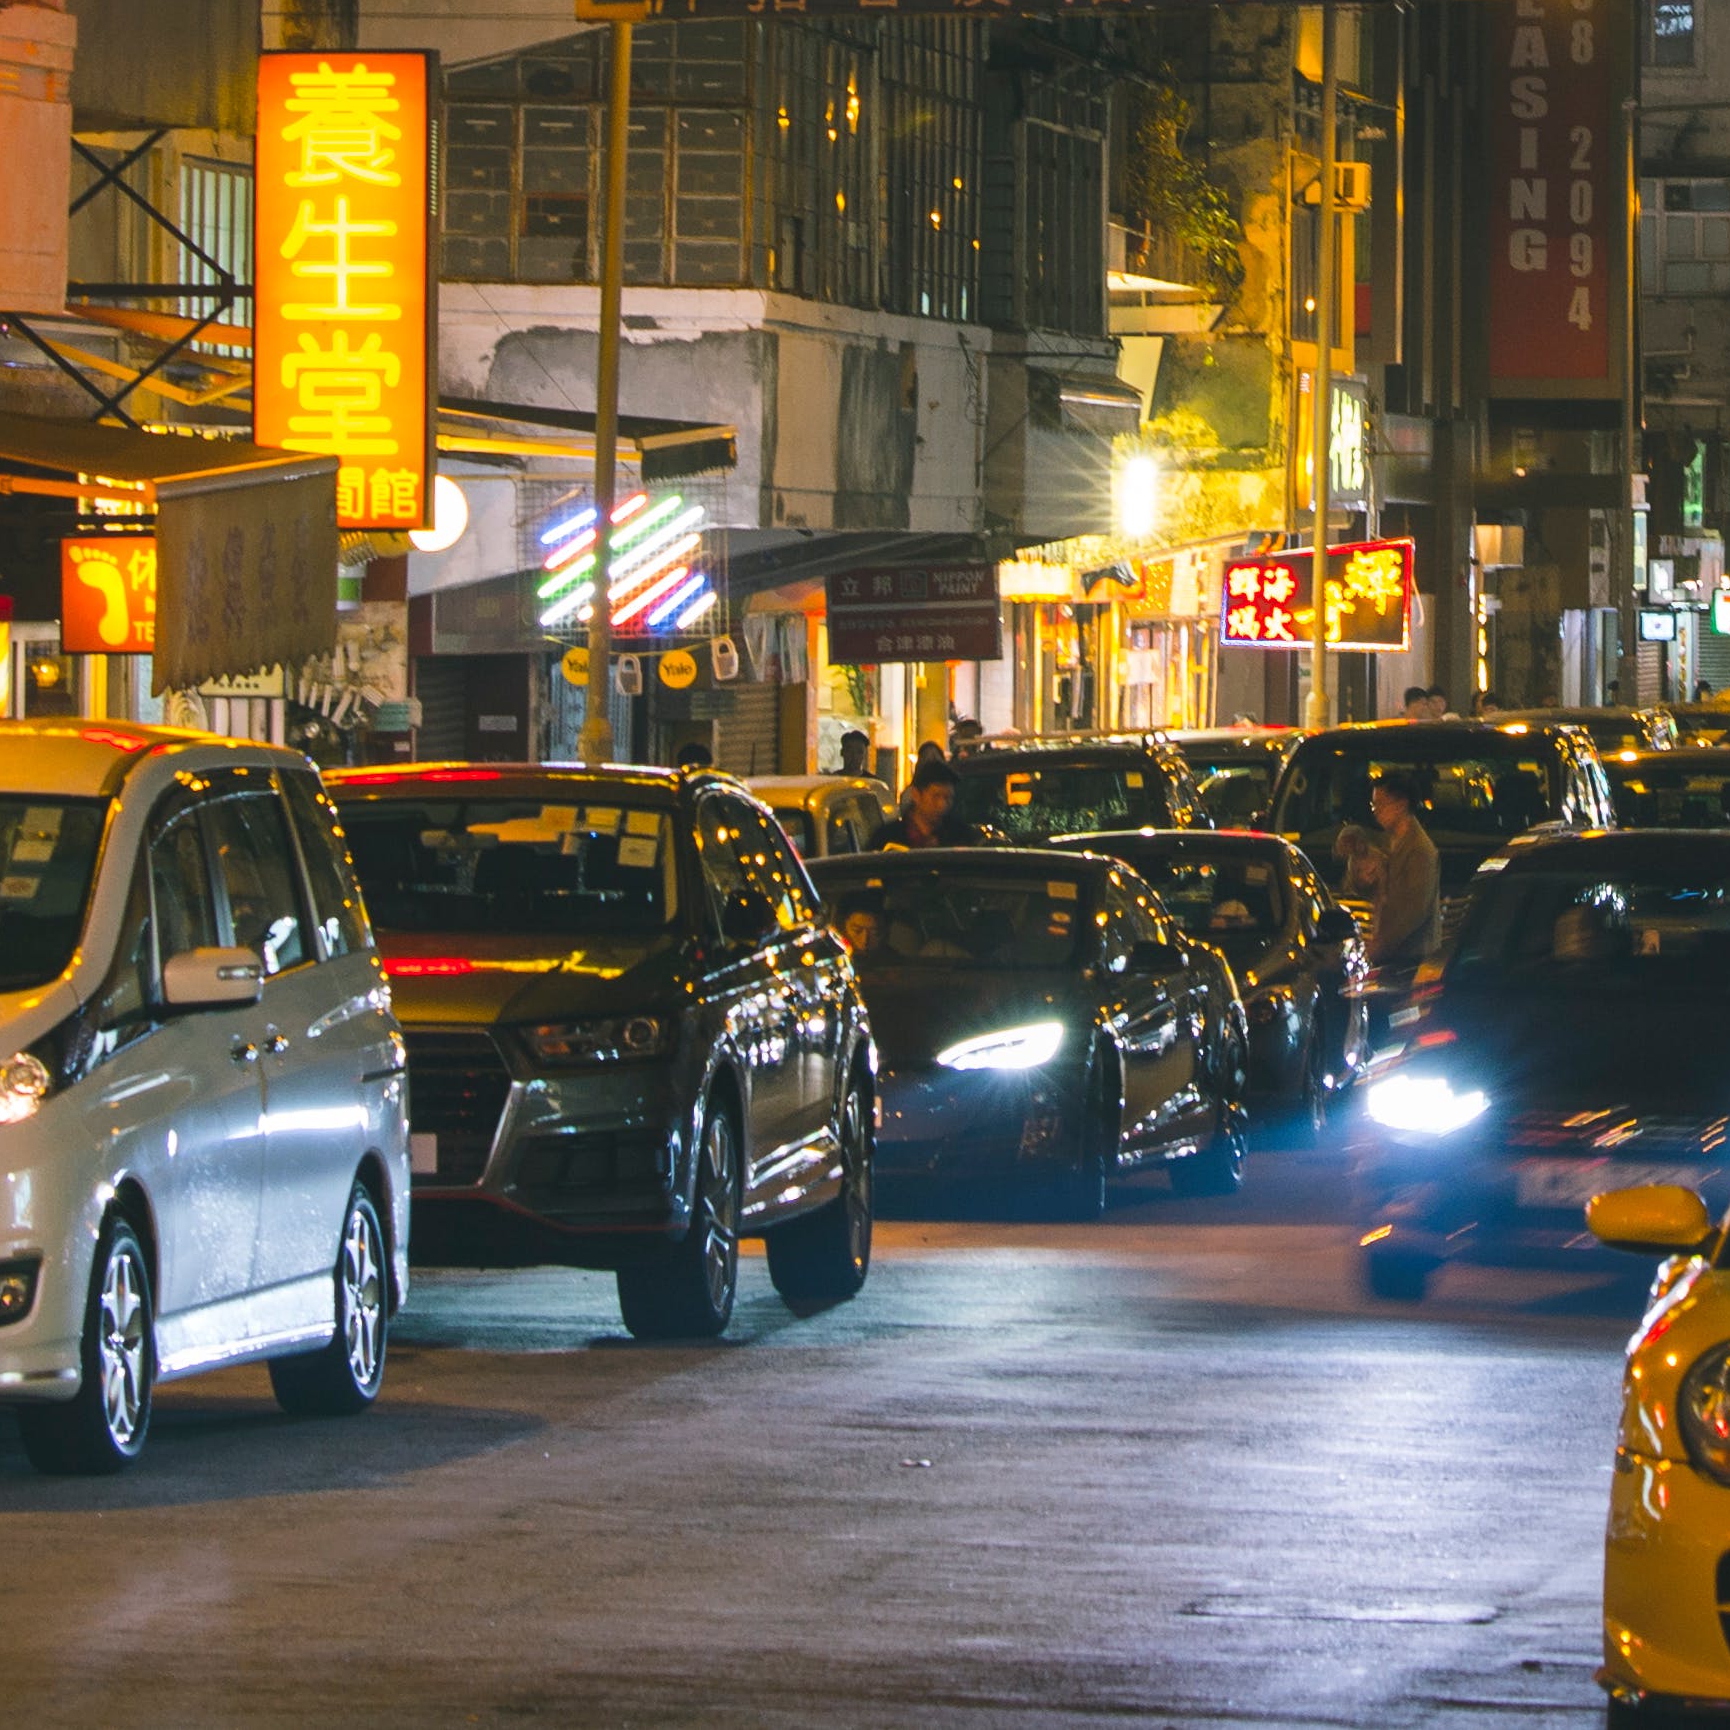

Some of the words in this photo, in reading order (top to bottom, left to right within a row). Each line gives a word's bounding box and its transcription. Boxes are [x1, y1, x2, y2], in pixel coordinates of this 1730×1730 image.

[279, 62, 403, 456] 養生堂
[1568, 127, 1594, 330] 2094
[663, 661, 693, 677] Yale
